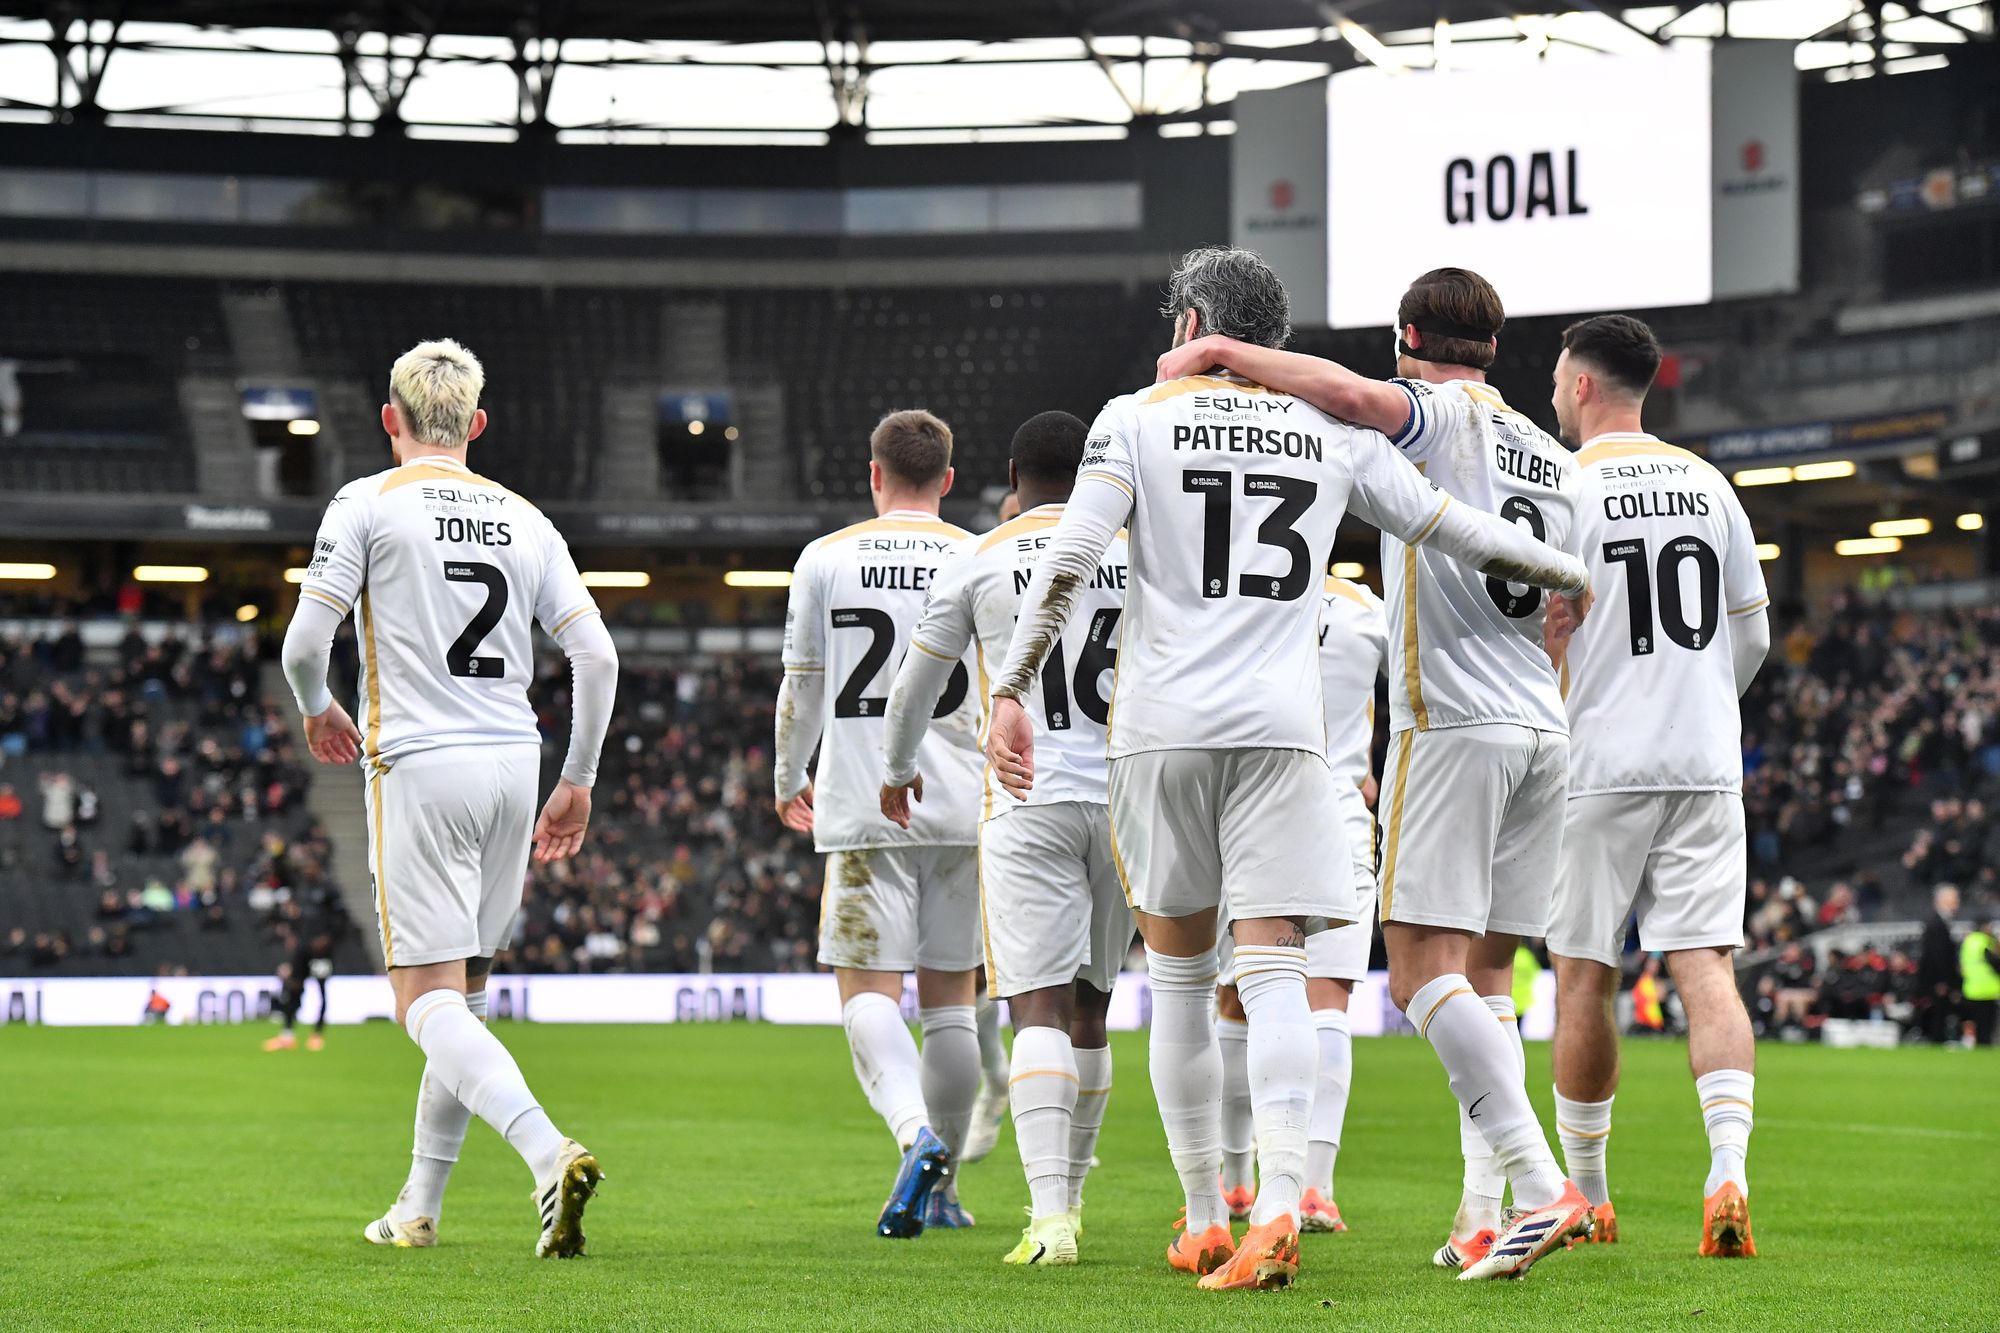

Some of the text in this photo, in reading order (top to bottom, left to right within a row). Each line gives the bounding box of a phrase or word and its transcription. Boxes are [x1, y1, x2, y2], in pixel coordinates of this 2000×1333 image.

[1446, 149, 1588, 224] GOAL
[1194, 396, 1294, 413] EQUITY
[1194, 413, 1262, 422] ENERGIES
[1174, 425, 1323, 463] PATERSON
[1496, 444, 1562, 491] GILBEY
[1600, 464, 1689, 479] EQUITY
[422, 488, 506, 506] EQUITY
[1603, 491, 1709, 521] COLLINS
[435, 517, 512, 546] JONES
[859, 540, 949, 552] EQUITY
[1183, 469, 1318, 601] 13
[1602, 535, 1720, 657] 10
[443, 561, 508, 678] 2
[199, 990, 272, 1020] GOA
